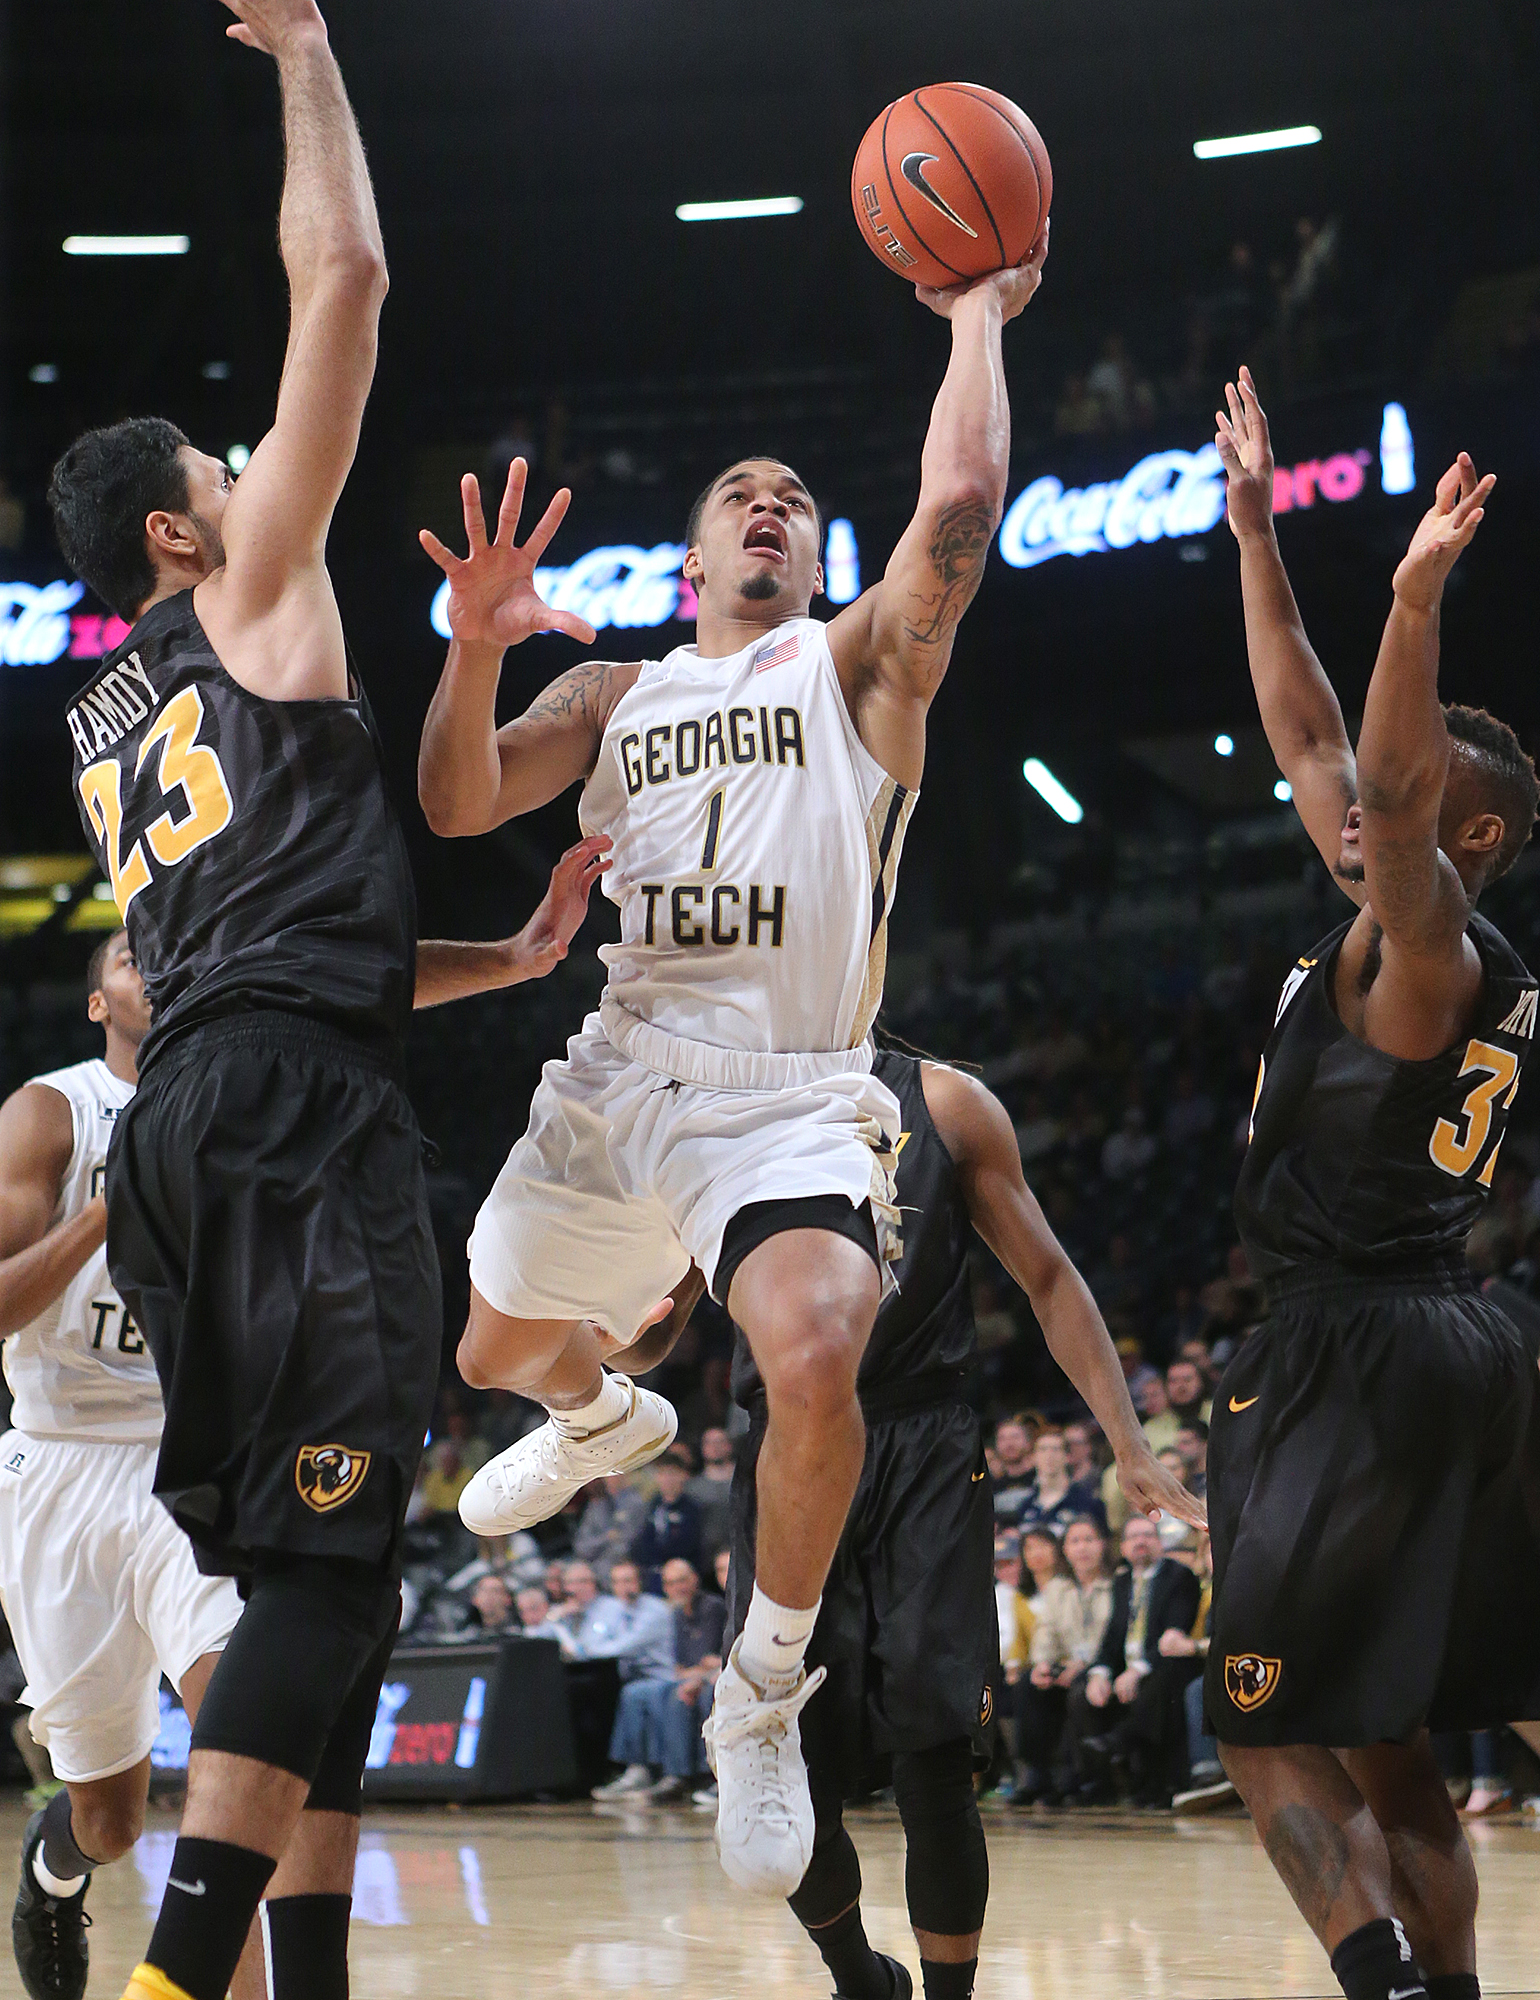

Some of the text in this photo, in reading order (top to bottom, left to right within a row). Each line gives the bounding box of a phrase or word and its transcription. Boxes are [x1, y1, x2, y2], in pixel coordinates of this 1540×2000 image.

[862, 183, 918, 268] ELITE
[66, 650, 161, 764] HAMDY
[620, 705, 806, 799] GEORGIA
[78, 684, 234, 926] 23
[700, 786, 726, 873] 1
[641, 884, 786, 947] TECH
